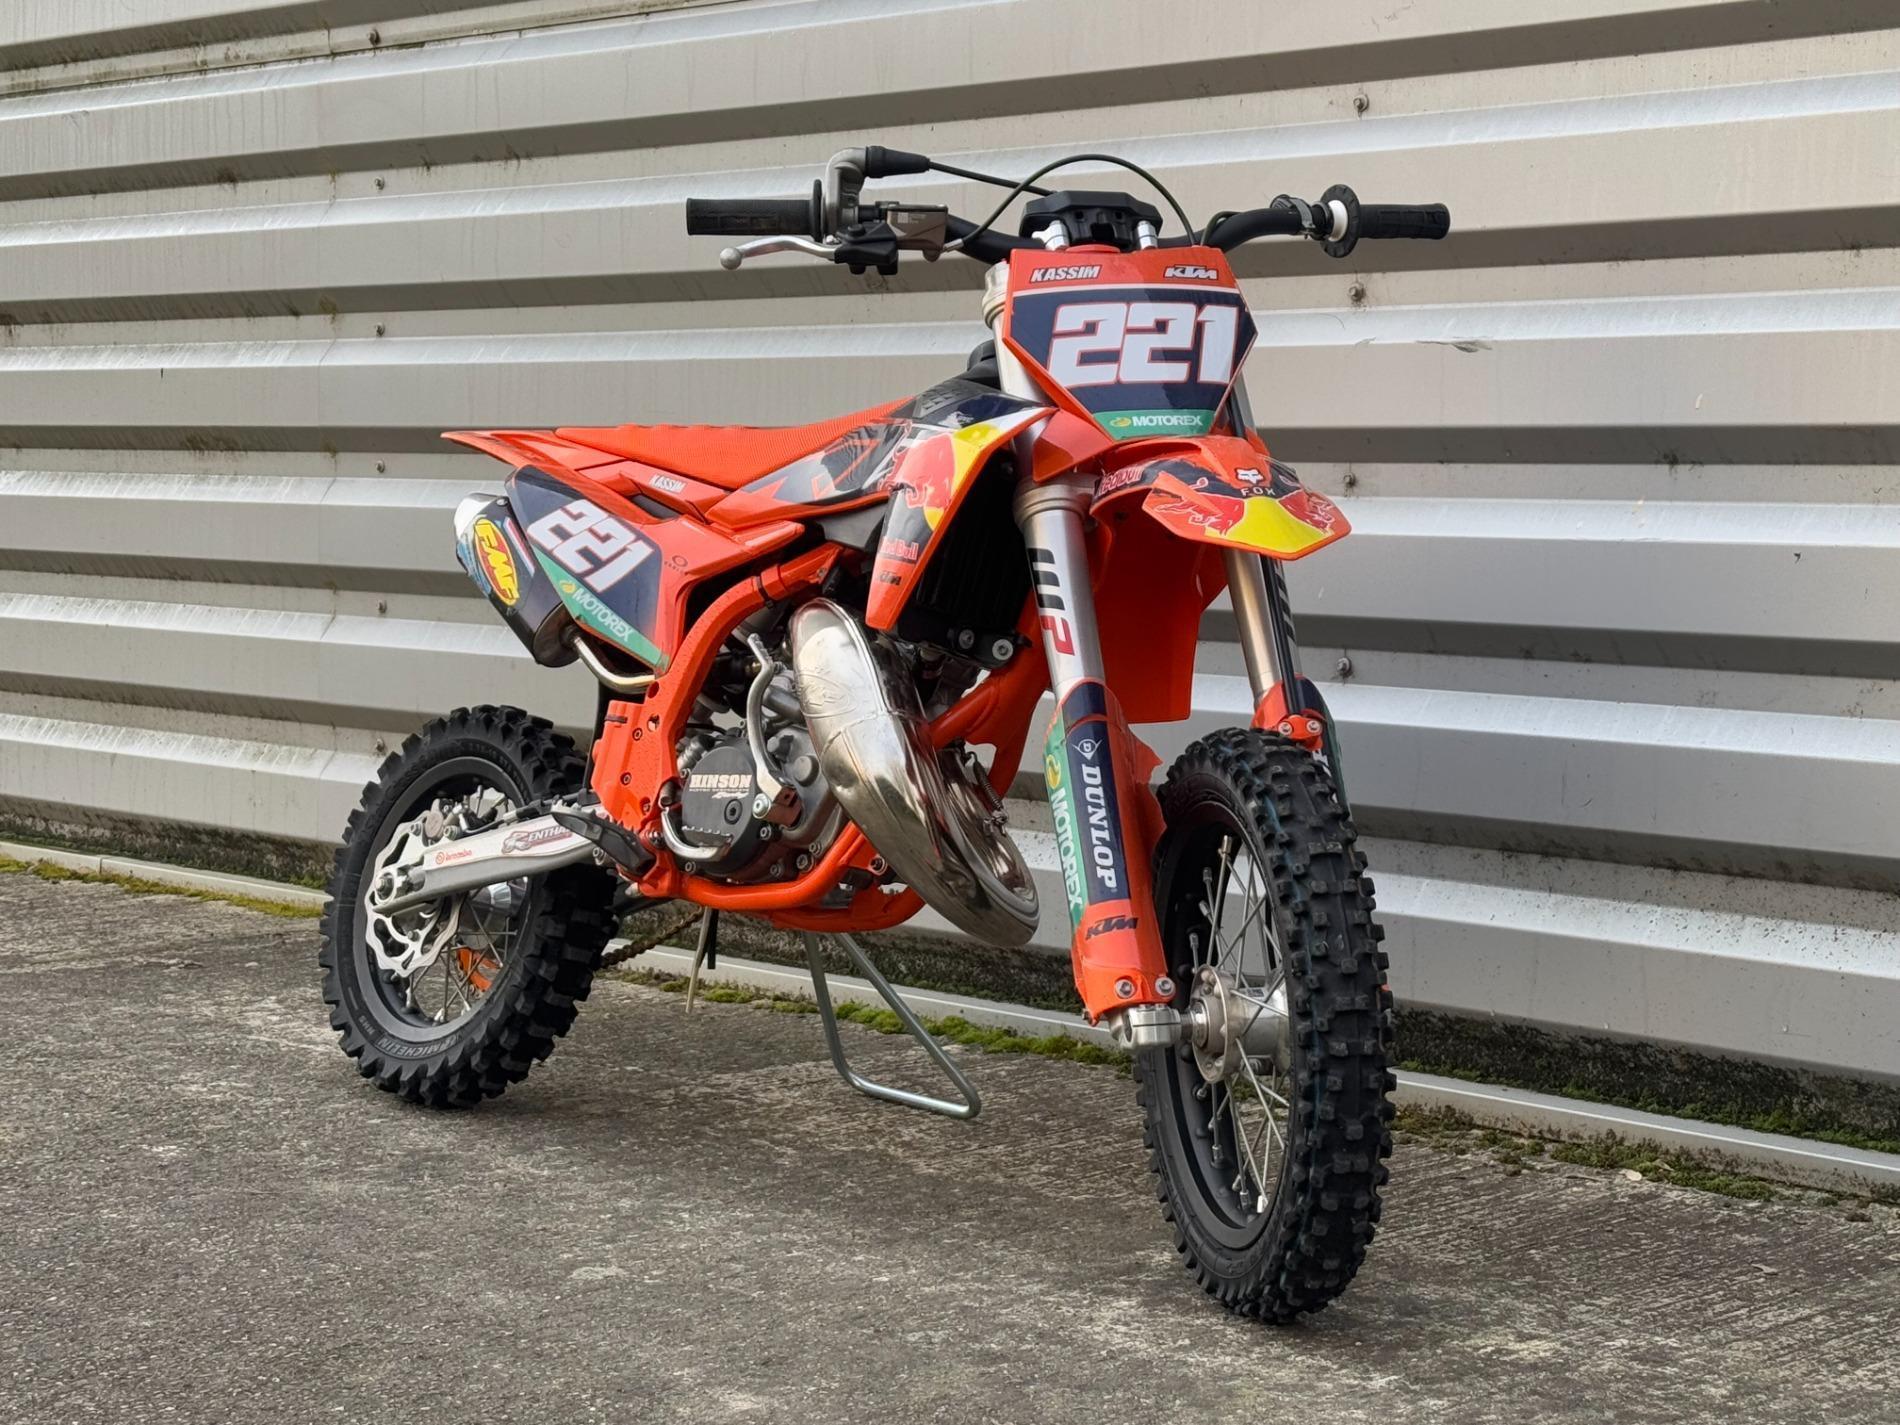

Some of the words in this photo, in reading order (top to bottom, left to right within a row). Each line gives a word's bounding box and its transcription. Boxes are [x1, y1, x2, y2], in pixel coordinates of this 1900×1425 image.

[1030, 265, 1102, 283] KASSIM
[1163, 264, 1219, 281] KTM
[1046, 301, 1239, 389] 221
[1132, 414, 1203, 427] MOTOREX
[649, 474, 687, 494] KASSIM
[1240, 486, 1276, 497] FOX
[526, 498, 656, 594] 221
[475, 523, 520, 600] FMF
[572, 587, 634, 643] MOTOREX
[689, 774, 752, 789] HINSON
[1081, 764, 1118, 890] DUNLOP
[1050, 787, 1084, 911] MOTOREX
[1085, 915, 1139, 940] KTM
[377, 1038, 438, 1058] MICHELIN
